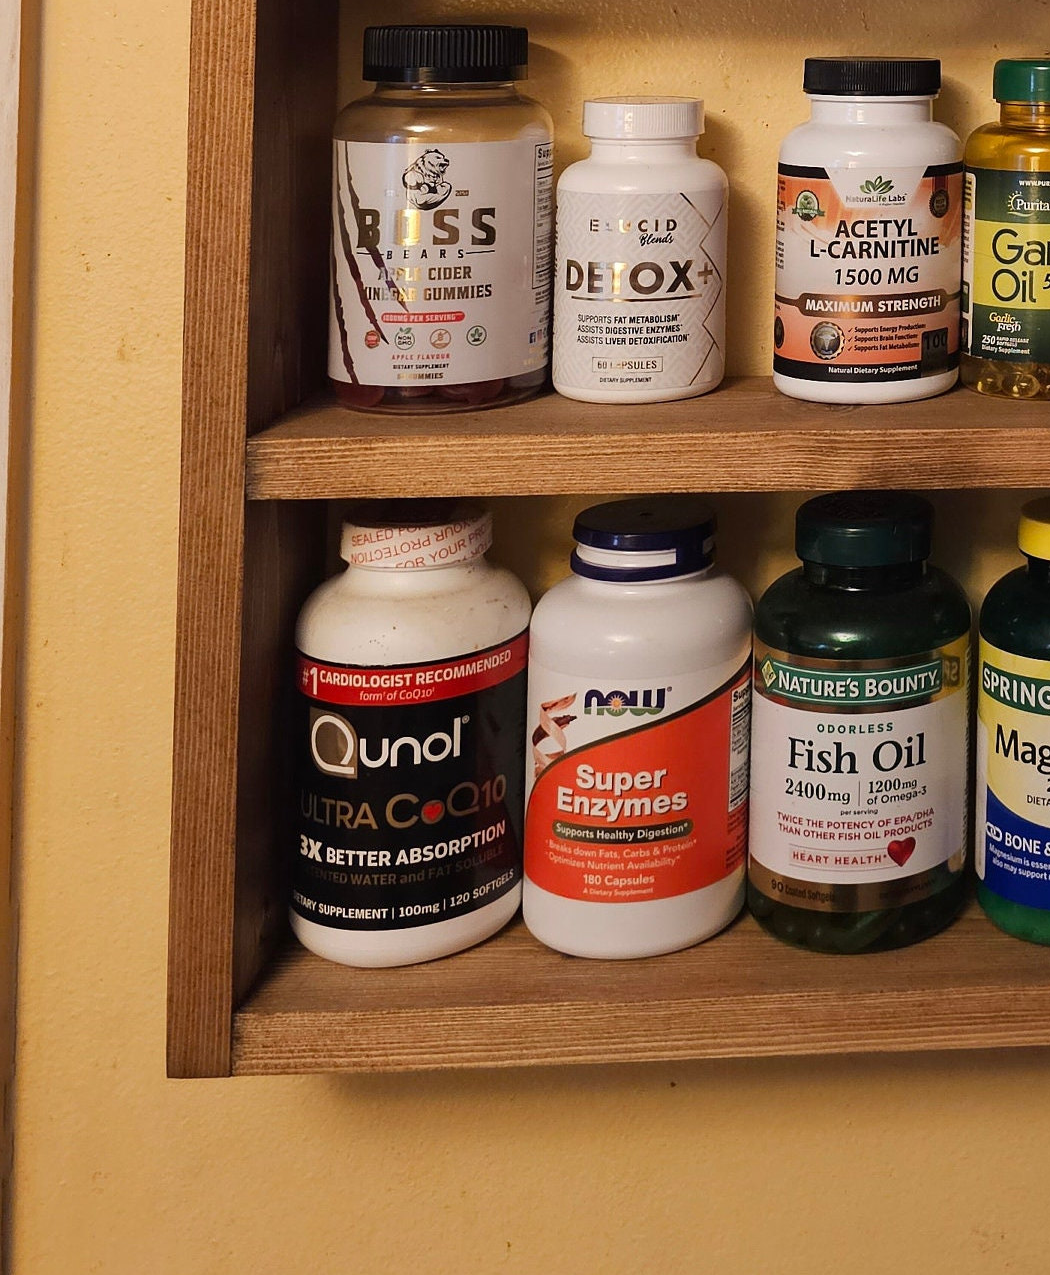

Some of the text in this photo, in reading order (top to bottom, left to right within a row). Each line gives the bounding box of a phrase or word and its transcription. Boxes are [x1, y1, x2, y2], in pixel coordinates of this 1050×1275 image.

[639, 233, 674, 246] Blends
[835, 219, 917, 238] ACETYL
[387, 249, 464, 259] BEARS
[810, 237, 939, 259] L-CARNITINE
[835, 266, 919, 285] 1500 MG
[992, 269, 1036, 303] Oil
[805, 296, 940, 313] MAXIMUM STRENGTH
[320, 650, 511, 689] CARDIOLOGIST RECOMMENDED
[778, 668, 939, 698] NATURE'S BOUNTY
[817, 722, 893, 734] ODORLESS
[312, 714, 460, 775] Qunol
[788, 733, 926, 774] Fish Oil
[576, 765, 666, 796] Super
[300, 789, 378, 830] ULTRA
[557, 786, 688, 822] Enzymes
[300, 820, 506, 867] 3X BETTER ABSORPTION
[556, 823, 594, 839] Supports
[597, 830, 634, 841] Healthy
[792, 851, 829, 864] HEART
